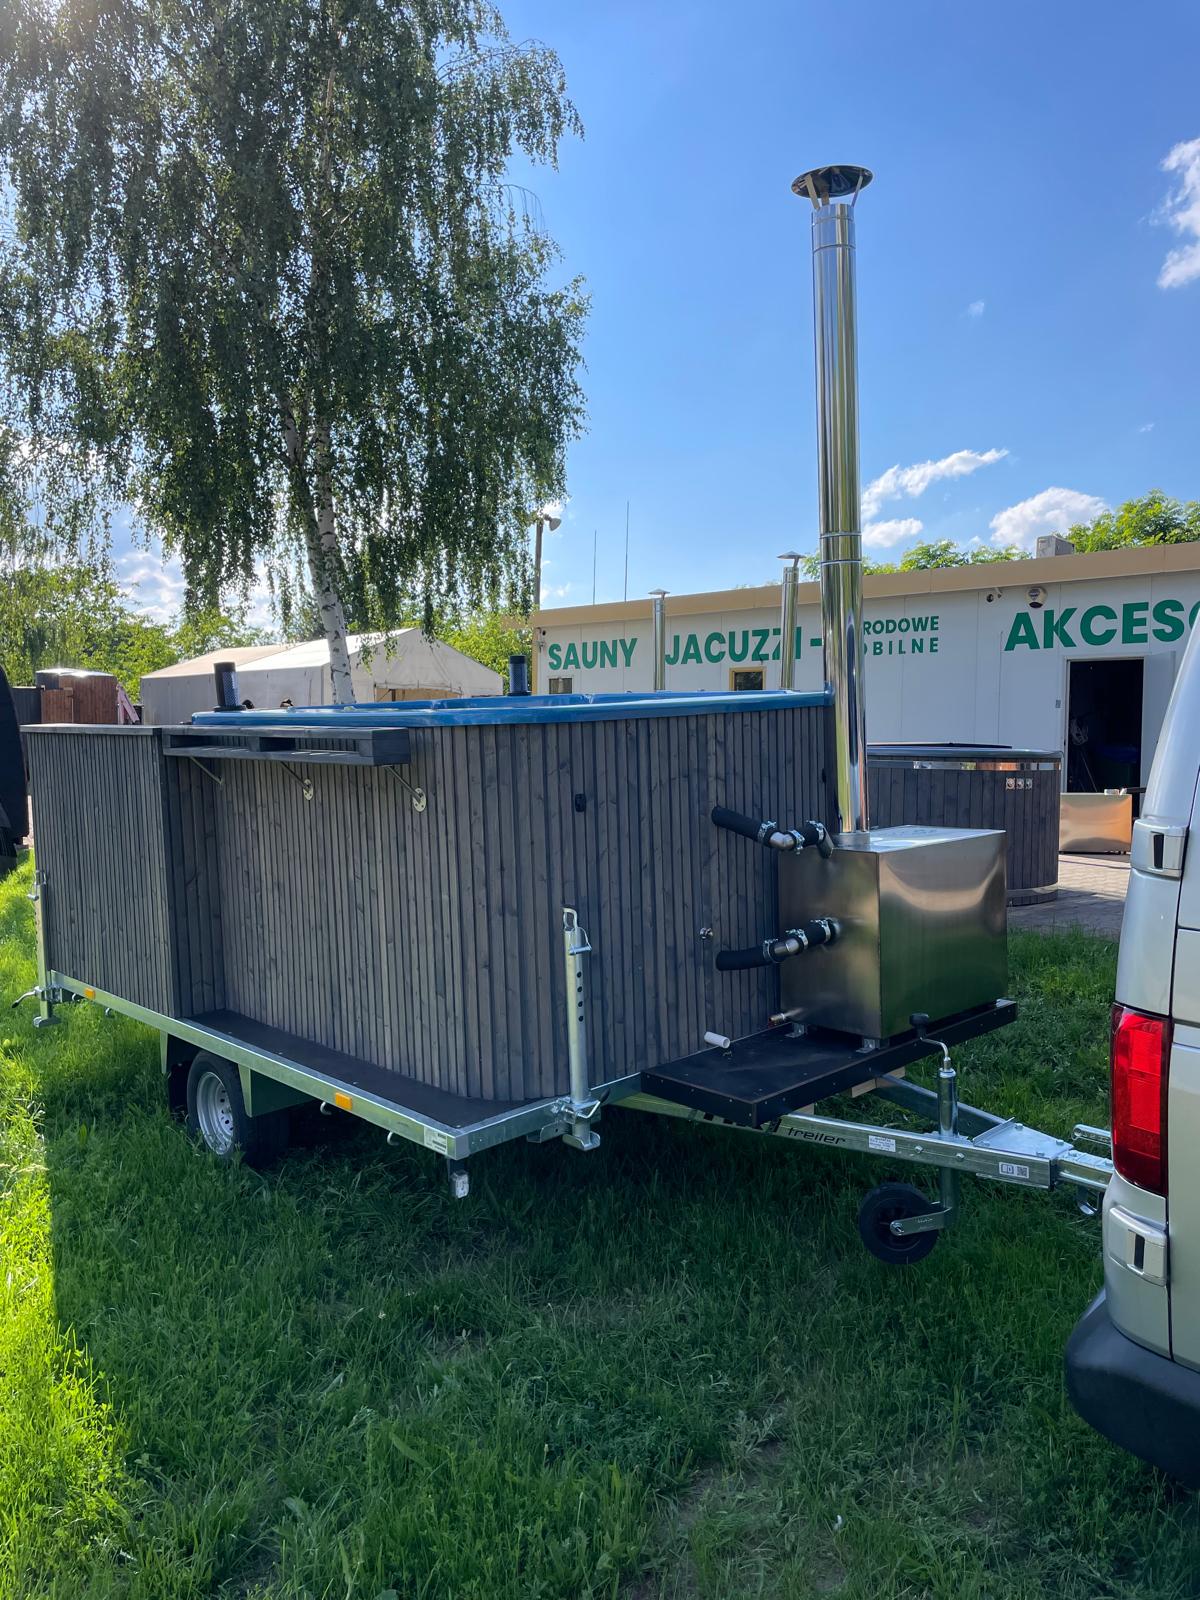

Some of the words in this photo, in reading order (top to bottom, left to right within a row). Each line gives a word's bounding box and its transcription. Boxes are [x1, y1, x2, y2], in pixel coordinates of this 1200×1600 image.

[863, 615, 939, 635] RODOWE
[1004, 599, 1200, 652] AKCES
[547, 637, 637, 670] SAUNY
[863, 637, 939, 657] BILNE
[787, 1126, 847, 1146] treiler
